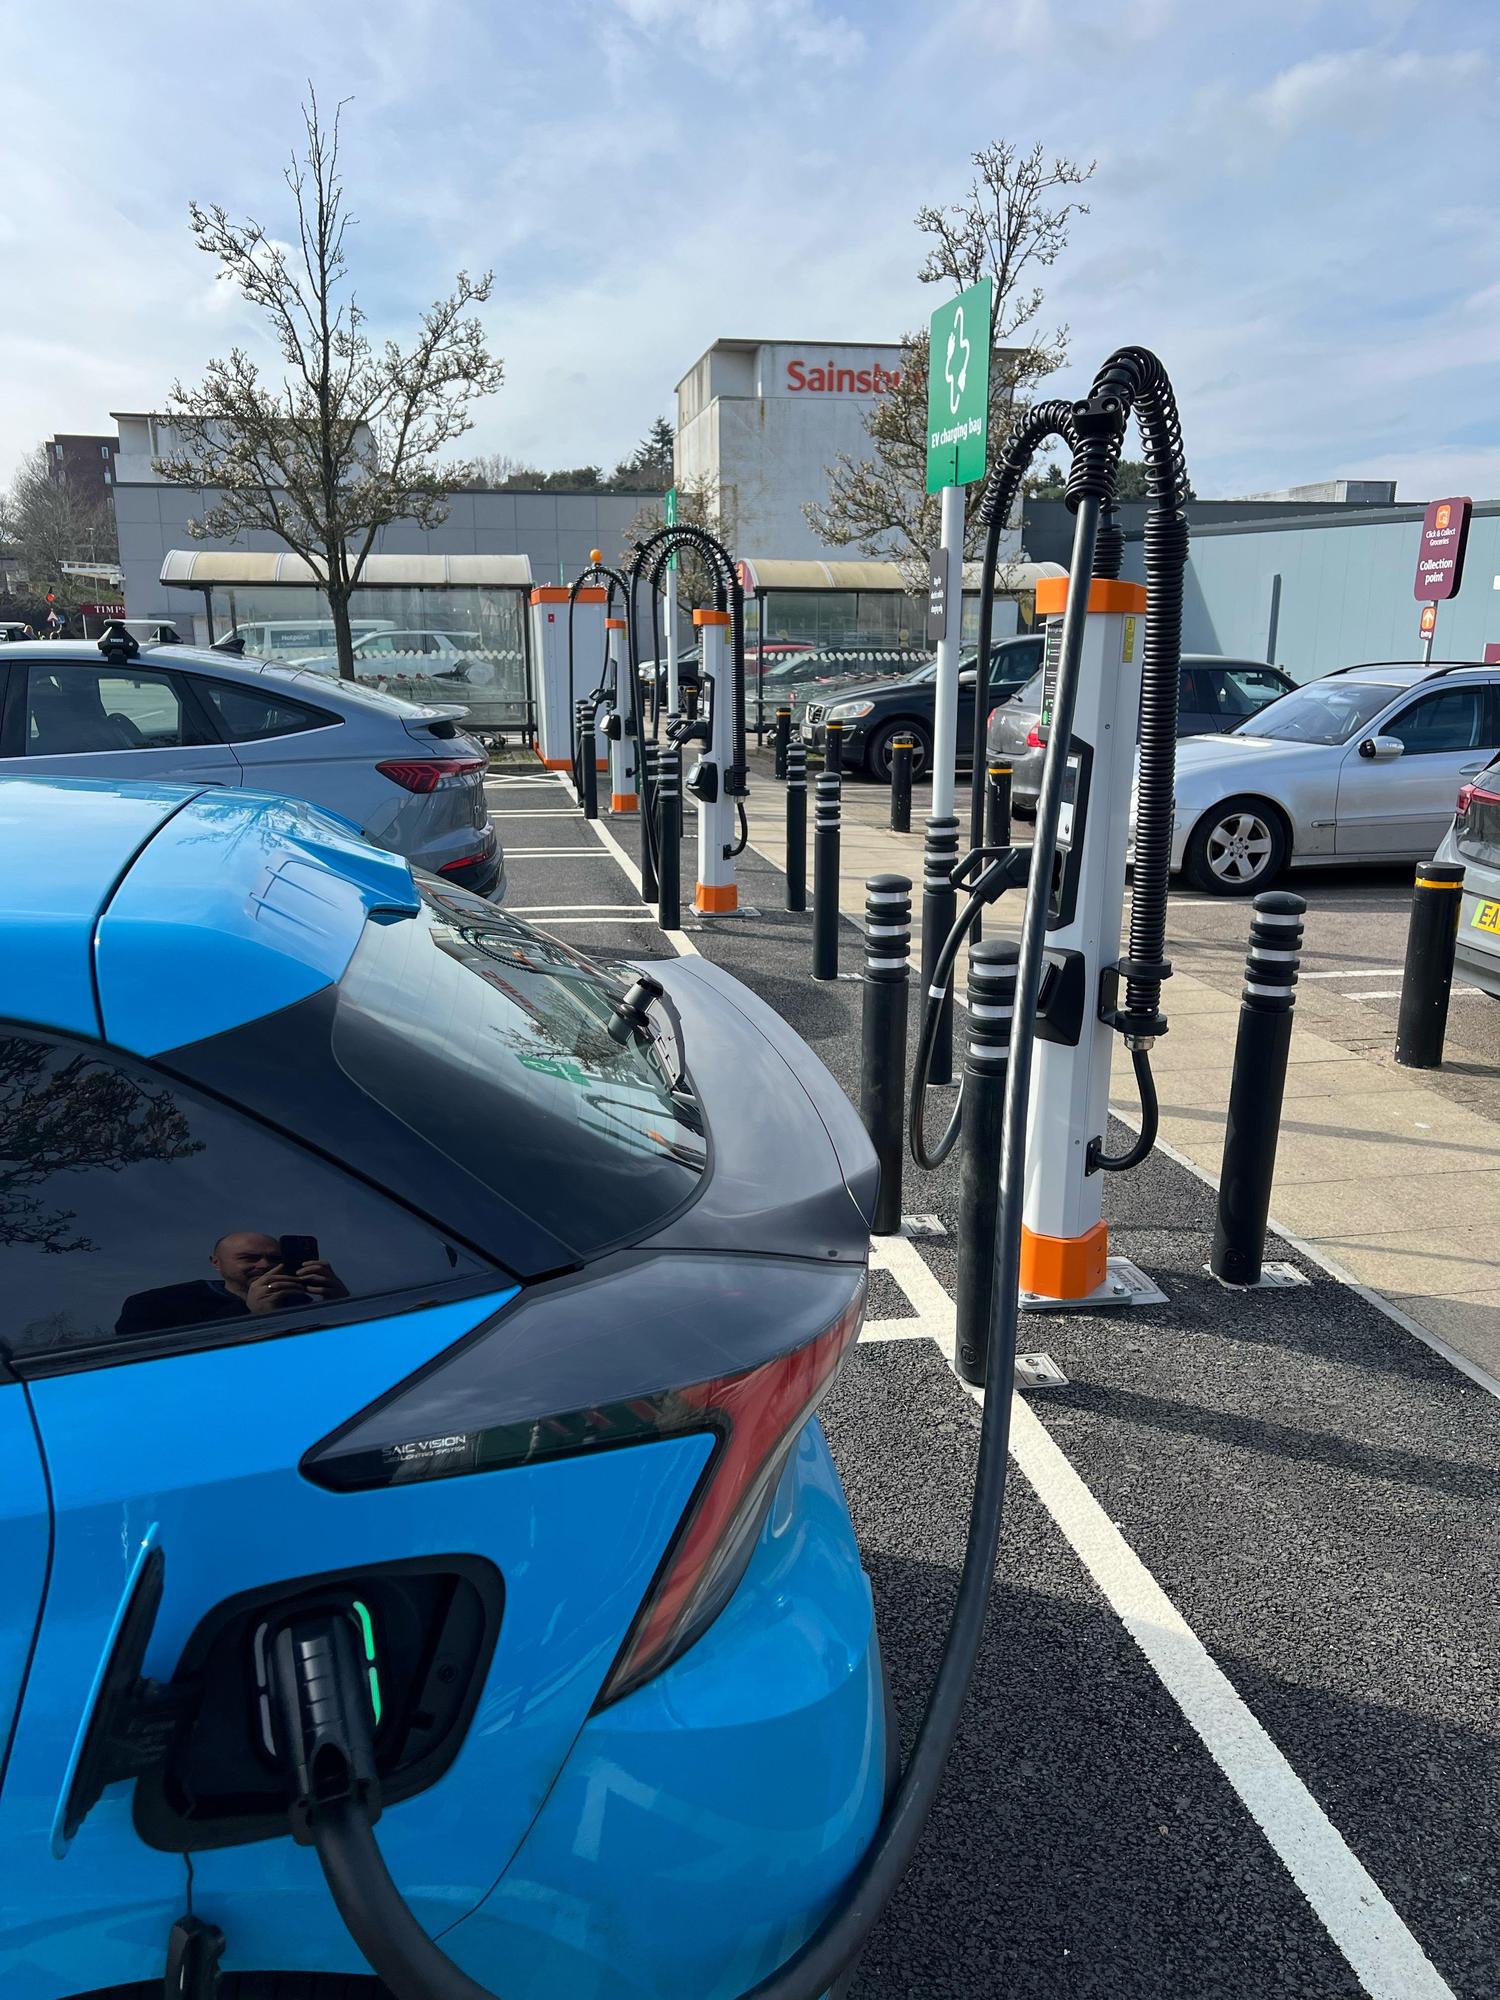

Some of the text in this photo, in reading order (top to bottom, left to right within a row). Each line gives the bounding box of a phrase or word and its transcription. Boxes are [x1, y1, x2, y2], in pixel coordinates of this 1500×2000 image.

[931, 416, 982, 448] EV charging bay
[1425, 530, 1436, 539] Click
[1441, 528, 1456, 537] Collect
[1419, 558, 1453, 571] Collection
[1424, 571, 1444, 586] point
[281, 632, 311, 642] Hotpoint
[418, 1435, 467, 1451] VISION
